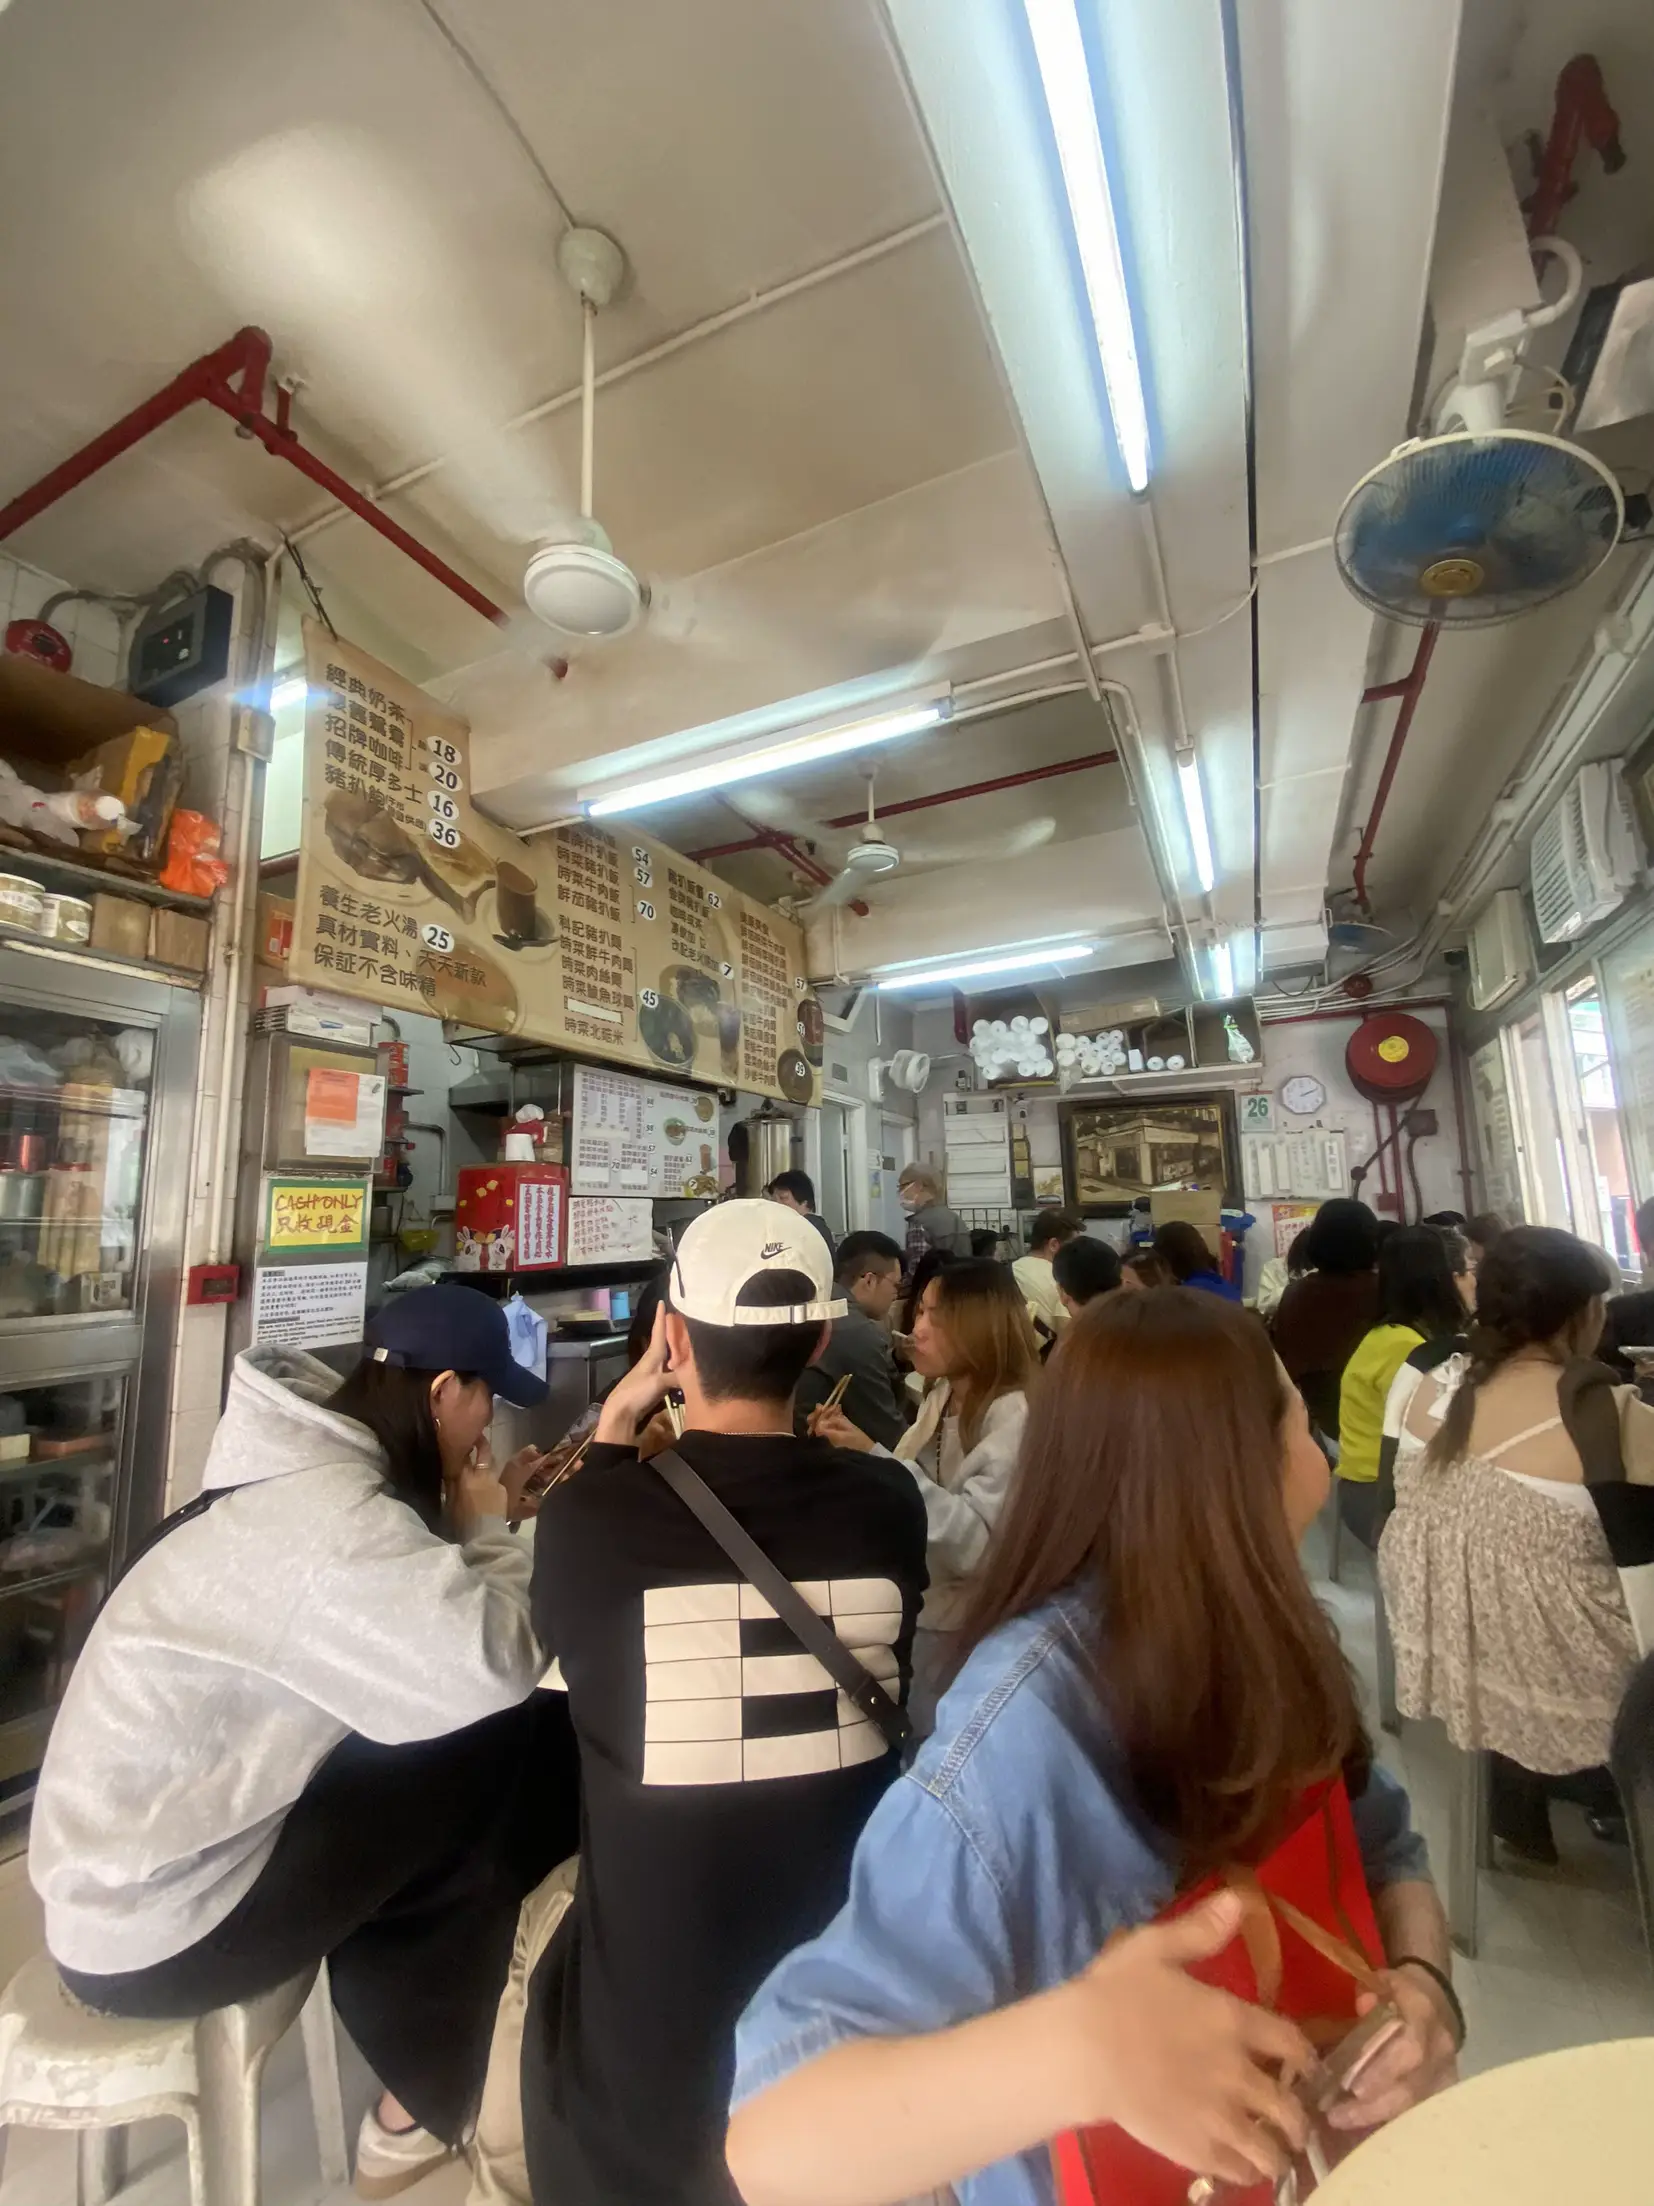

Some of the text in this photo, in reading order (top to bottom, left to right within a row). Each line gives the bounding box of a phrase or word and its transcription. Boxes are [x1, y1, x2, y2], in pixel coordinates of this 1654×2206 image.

[327, 663, 405, 725] 經典奶茶
[327, 688, 404, 748] 舊鴛鴦
[325, 713, 404, 772] 招牌咖啡
[434, 739, 456, 764] 18
[325, 739, 423, 804] 傳統厚多士
[434, 765, 457, 790] 20
[433, 795, 454, 818] 16
[433, 821, 456, 846] 36
[635, 848, 649, 866] 54
[637, 868, 650, 885] 57
[320, 885, 418, 939] 養生老火湯
[640, 901, 654, 919] 70
[707, 893, 720, 908] 62
[427, 927, 450, 950] 25
[314, 943, 436, 997] 保証不含味精
[796, 978, 804, 989] 57
[642, 990, 656, 1006] 45
[1247, 1097, 1269, 1118] 26
[275, 1193, 363, 1211] CASH ONLY
[276, 1213, 359, 1233] 只收現金
[765, 1242, 784, 1252] NIKE
